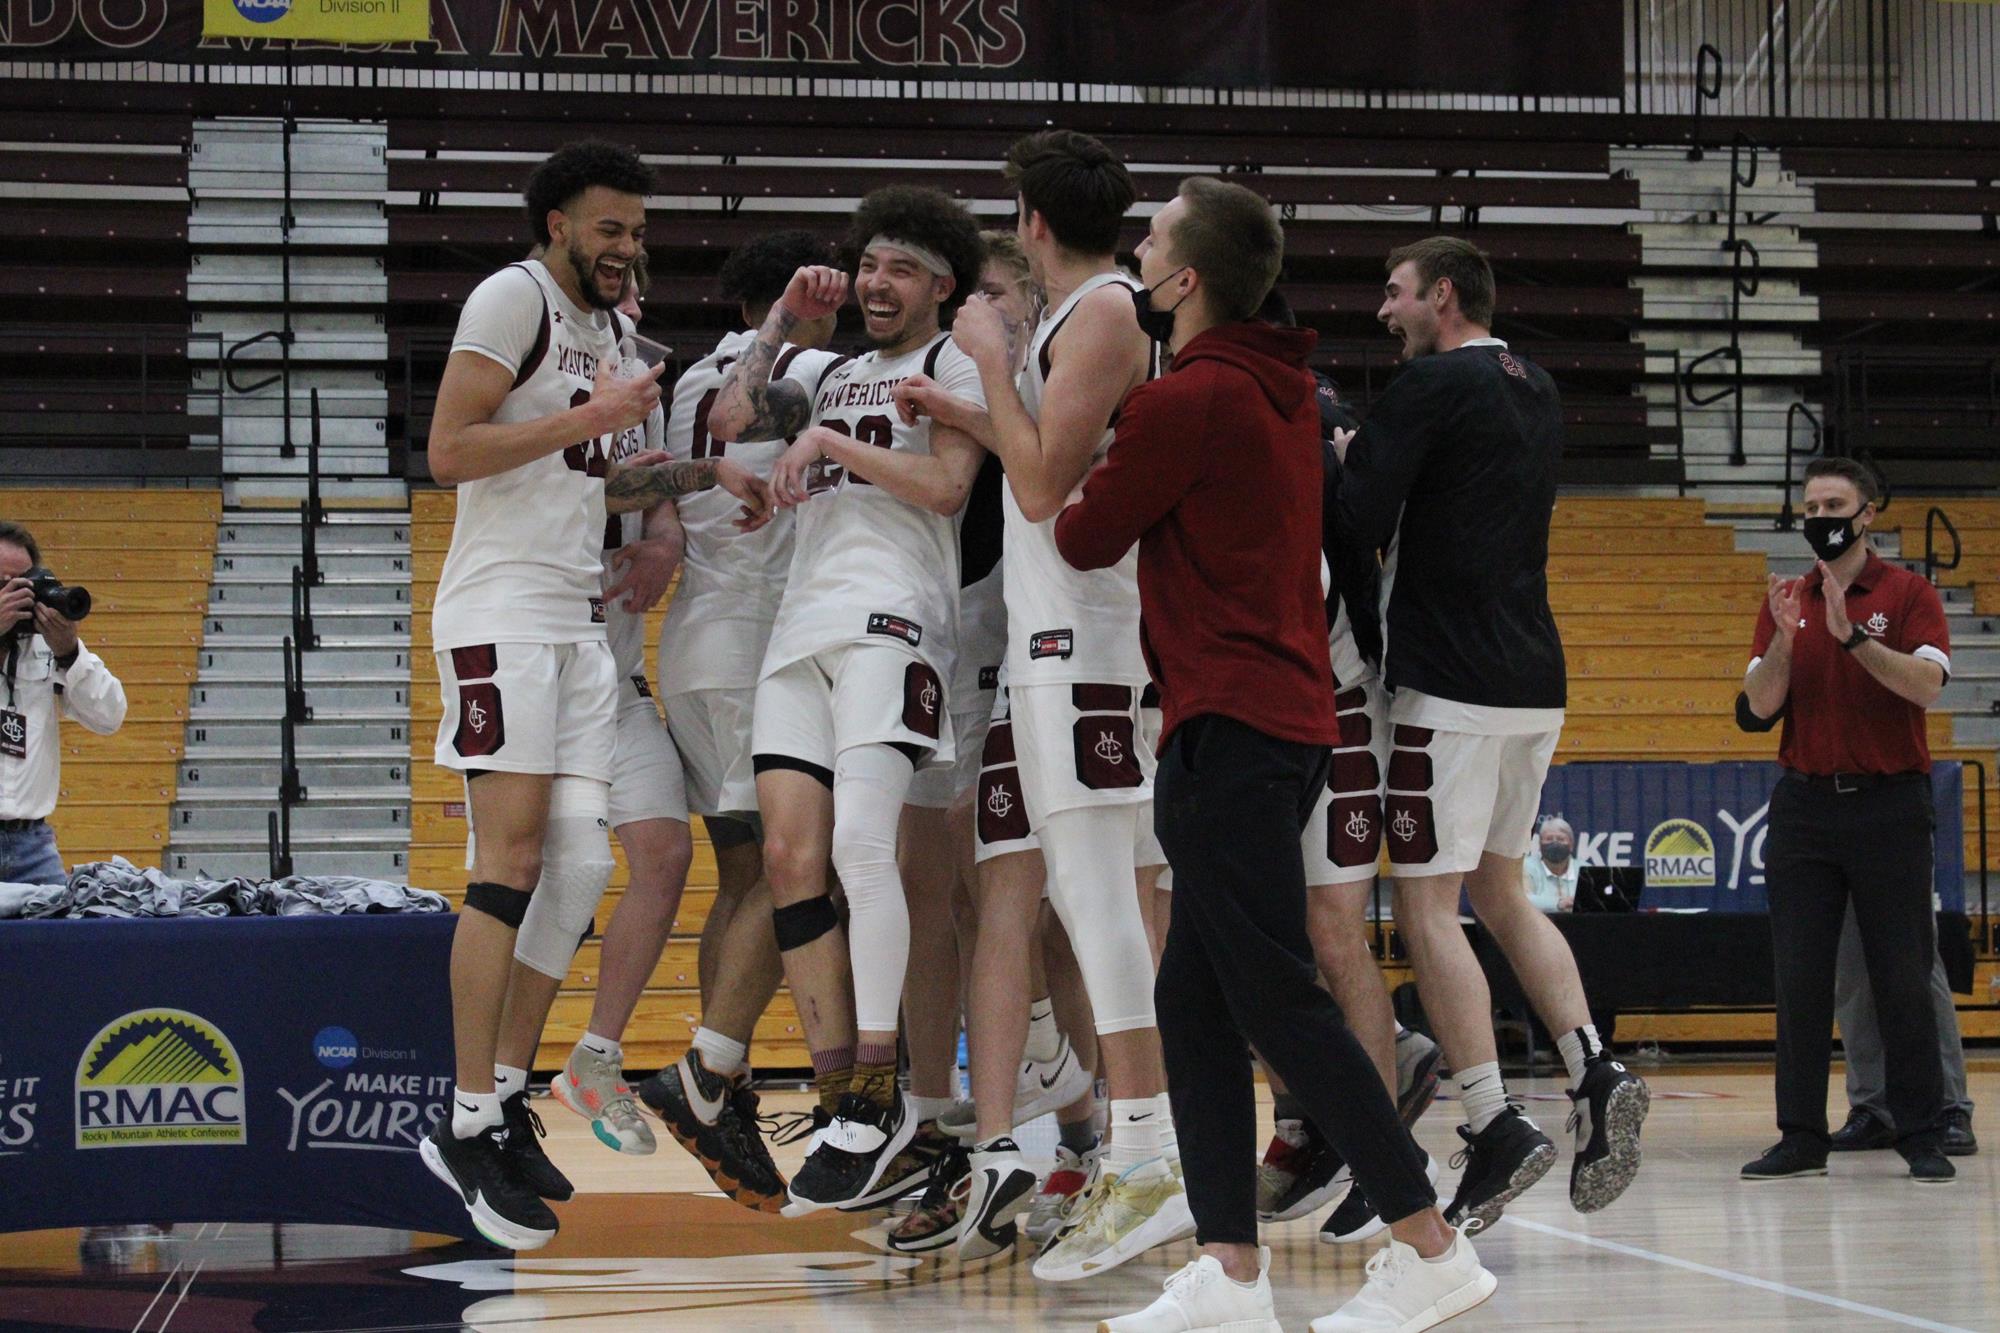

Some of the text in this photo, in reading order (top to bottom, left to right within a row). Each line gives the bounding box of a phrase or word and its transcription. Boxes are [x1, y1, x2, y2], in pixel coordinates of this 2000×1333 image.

[0, 0, 1026, 68] DO MAVERICKS
[227, 530, 236, 541] N
[394, 530, 402, 541] N
[223, 559, 234, 570] M
[392, 559, 403, 571] M
[214, 621, 224, 633] K
[393, 620, 403, 632] K
[195, 728, 207, 742] H
[391, 727, 401, 740] H
[187, 768, 199, 782] G
[389, 768, 401, 780] G
[182, 810, 193, 824] F
[391, 809, 401, 822] F
[177, 855, 187, 870] E
[393, 853, 403, 867] E
[1646, 857, 1713, 876] RMAC
[318, 1046, 357, 1058] NCAA
[362, 1047, 408, 1060] Division
[13, 1077, 40, 1097] IT
[344, 1073, 452, 1096] MAKE IT
[80, 1086, 239, 1126] RMAC
[82, 1126, 240, 1142] Rocky Mountain Athletic Conference
